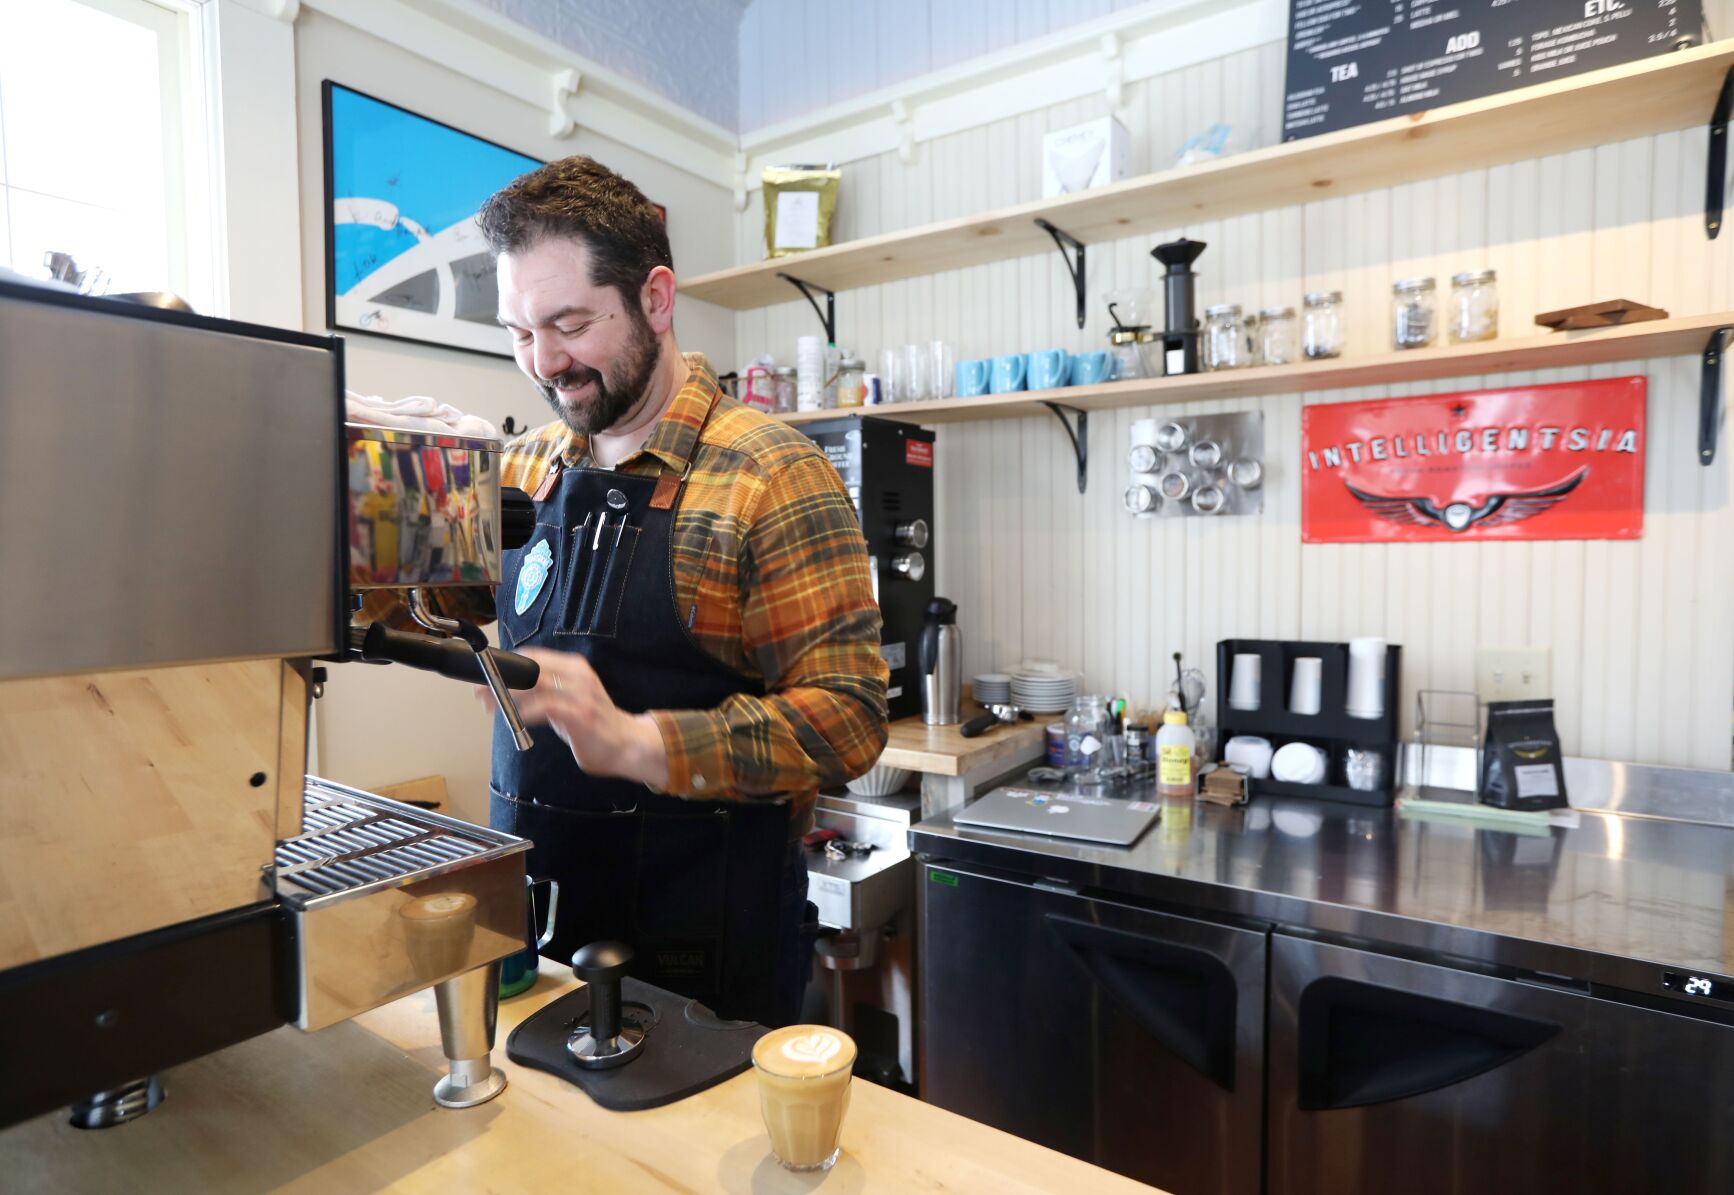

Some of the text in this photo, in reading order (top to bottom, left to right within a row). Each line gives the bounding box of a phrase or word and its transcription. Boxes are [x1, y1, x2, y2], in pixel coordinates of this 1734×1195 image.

[1445, 30, 1480, 55] ADD
[1330, 62, 1359, 83] TEA
[1308, 427, 1637, 471] INTELLIGENTSIA
[1684, 977, 1712, 995] 29
